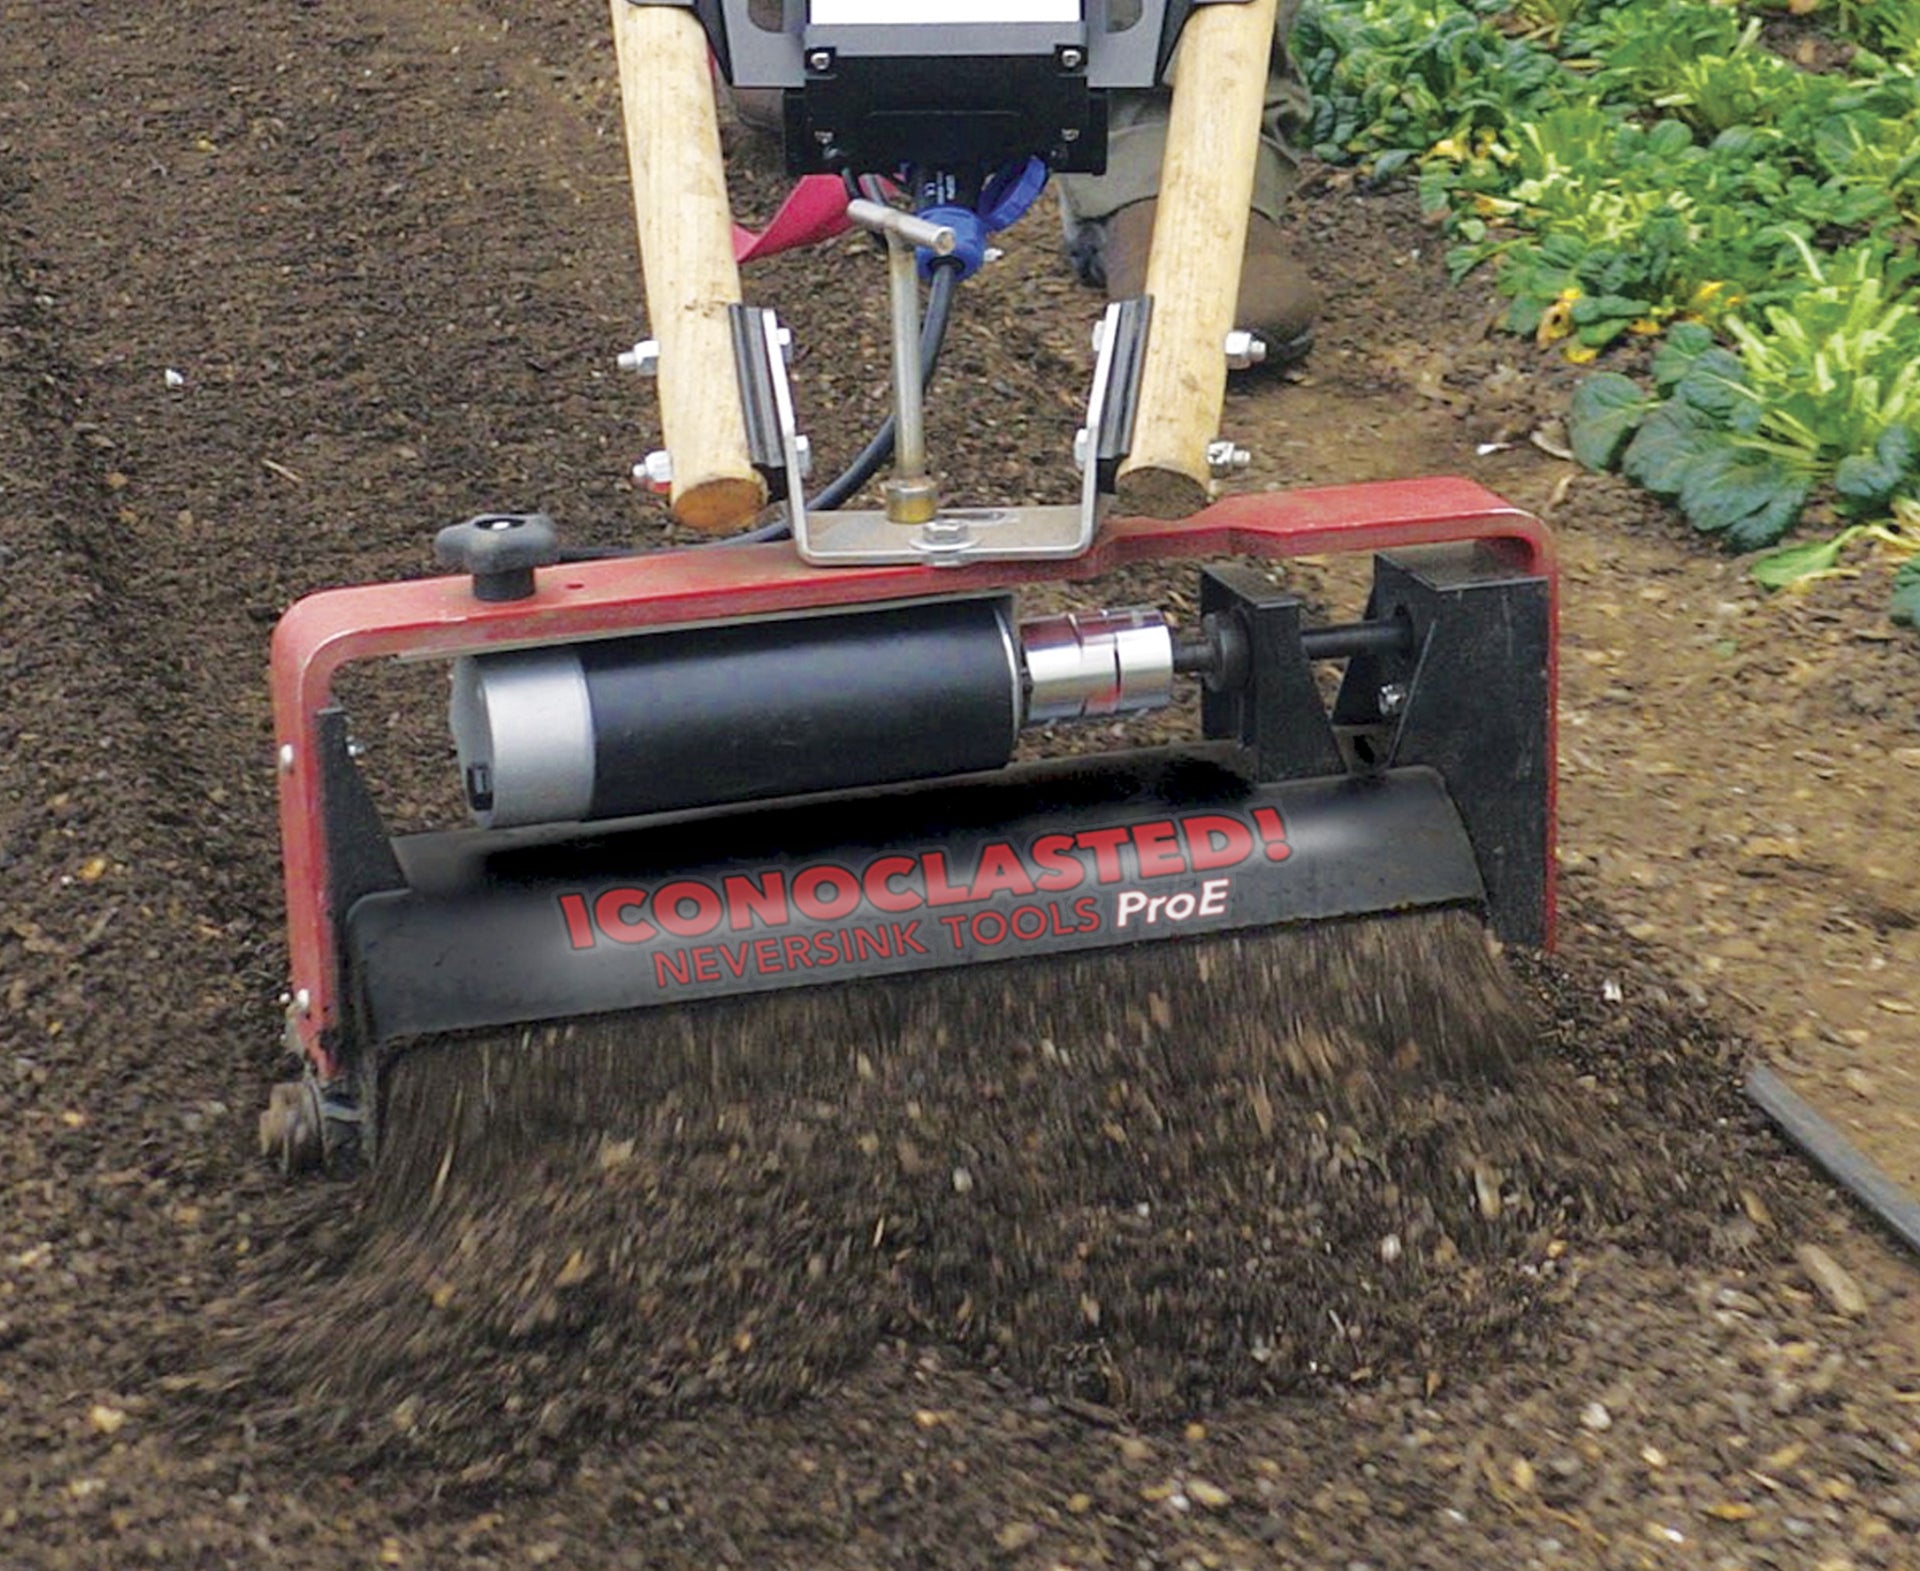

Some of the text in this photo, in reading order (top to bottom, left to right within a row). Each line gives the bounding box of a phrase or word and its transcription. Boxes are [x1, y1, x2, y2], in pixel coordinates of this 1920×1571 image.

[559, 807, 1292, 950] ICONOCLASTED!
[651, 878, 1230, 988] NEVERSINK TOOLS ProE
